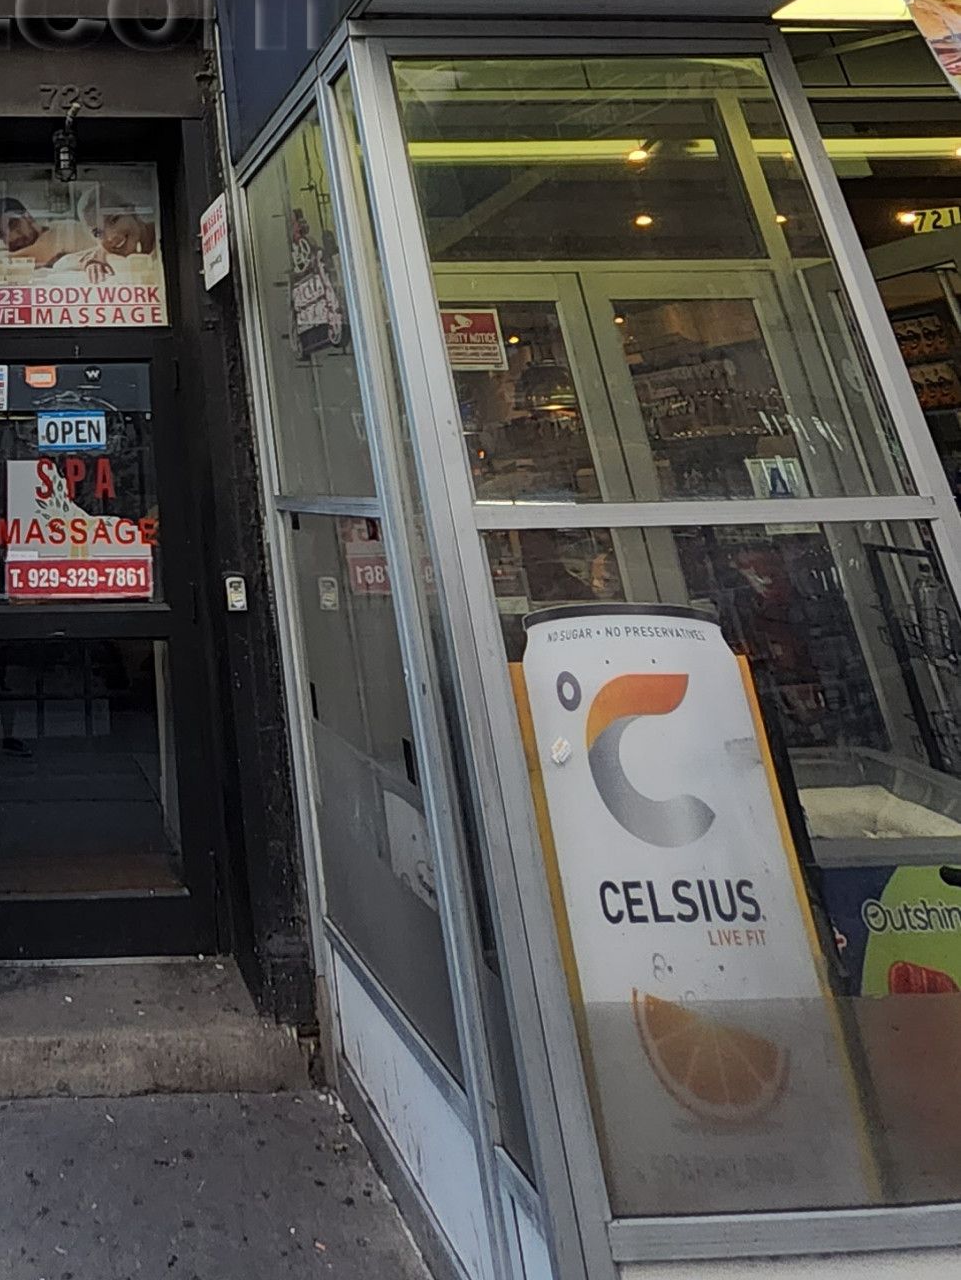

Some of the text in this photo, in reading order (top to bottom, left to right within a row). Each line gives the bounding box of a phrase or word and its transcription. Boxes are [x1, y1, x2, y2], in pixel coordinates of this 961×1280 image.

[39, 83, 105, 111] 723
[914, 208, 955, 232] 721
[35, 287, 93, 304] BODY
[97, 286, 161, 304] WORK
[36, 306, 163, 325] MASSAGE
[45, 420, 101, 444] OPEN
[35, 456, 116, 501] SPA
[9, 567, 146, 588] T. 929-329-7861
[560, 627, 593, 641] SUGAR
[604, 626, 621, 638] NO
[624, 625, 707, 642] PRESERVATIVES
[599, 878, 762, 925] CELSIUS
[707, 928, 766, 946] LIVE FIT
